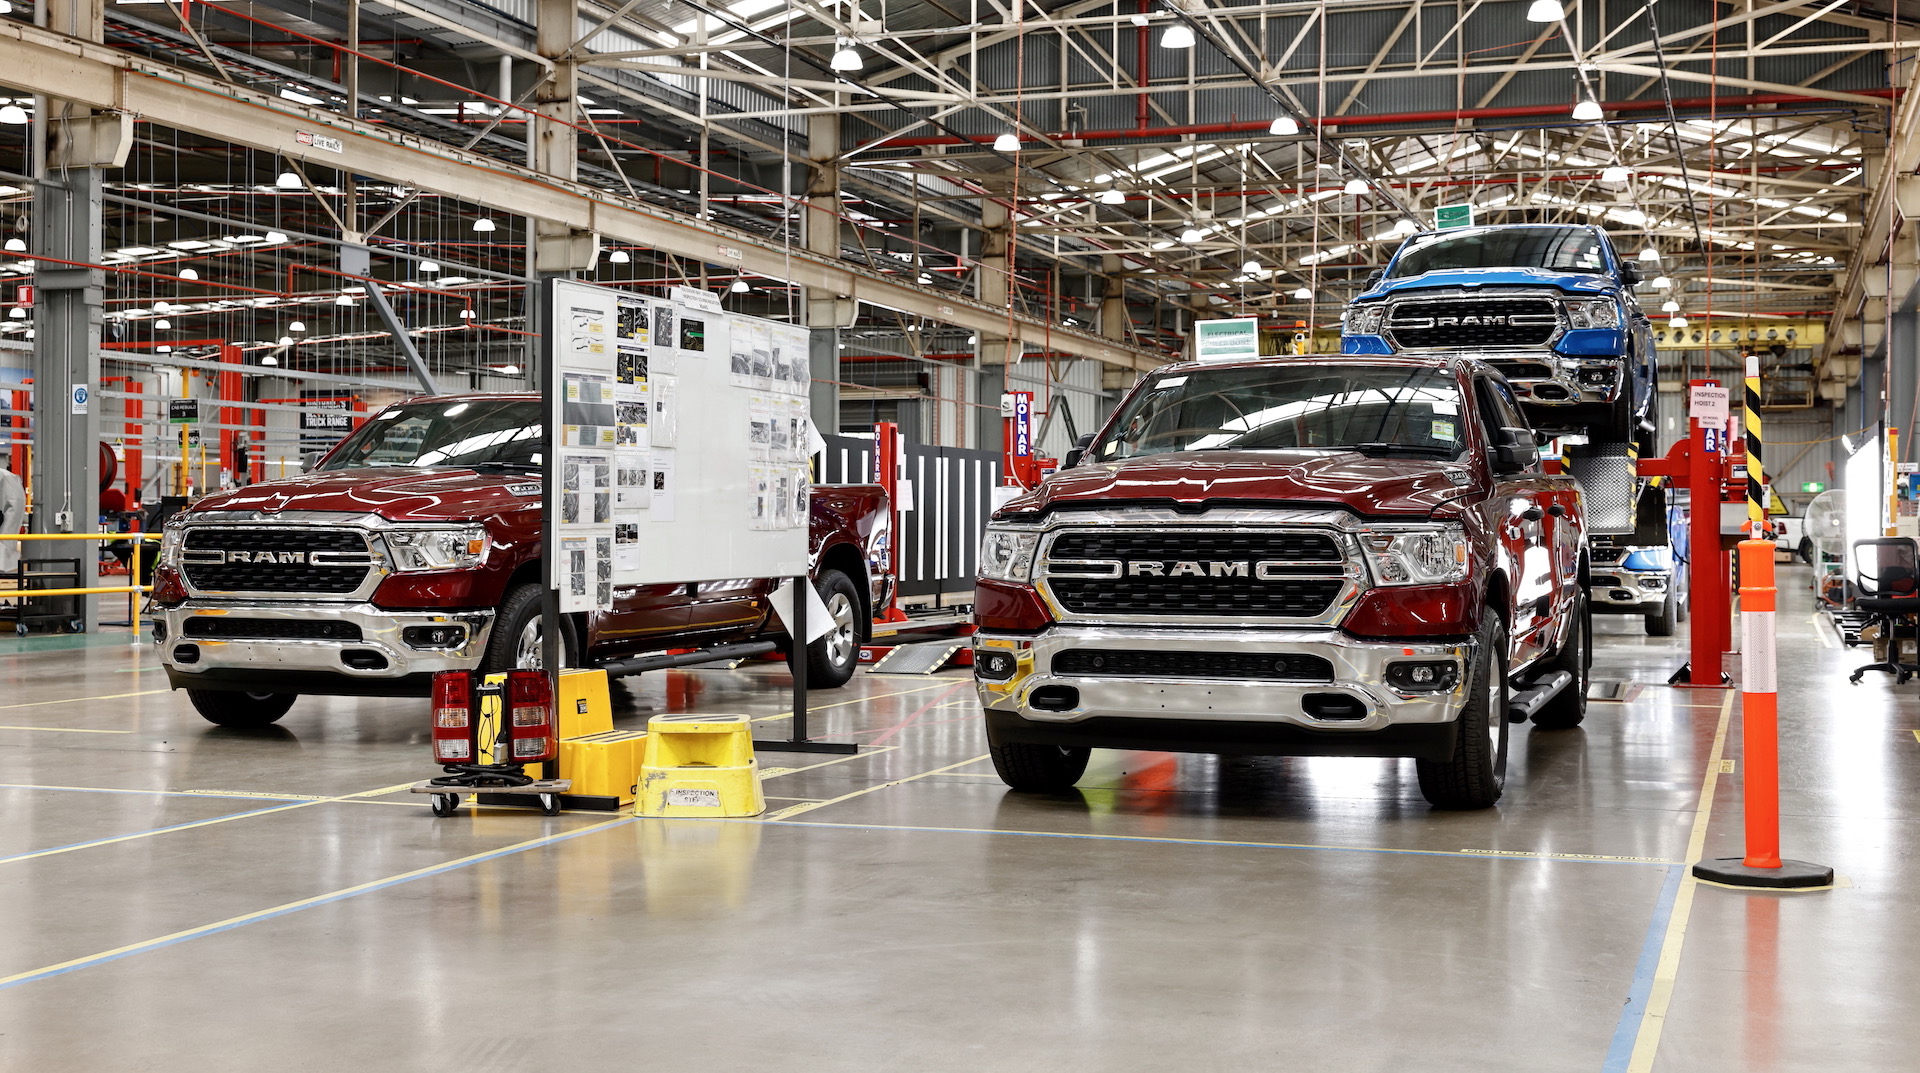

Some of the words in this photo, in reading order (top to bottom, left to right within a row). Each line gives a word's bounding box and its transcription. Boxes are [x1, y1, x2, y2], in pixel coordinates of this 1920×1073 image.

[314, 138, 325, 147] LIVE
[1437, 315, 1505, 326] RAM
[1694, 391, 1726, 399] INSPECTION
[306, 417, 326, 427] TRUCK
[327, 417, 348, 427] RANGE
[1017, 393, 1028, 455] MOLNAR
[228, 551, 305, 563] RAM
[1128, 560, 1249, 577] RAM
